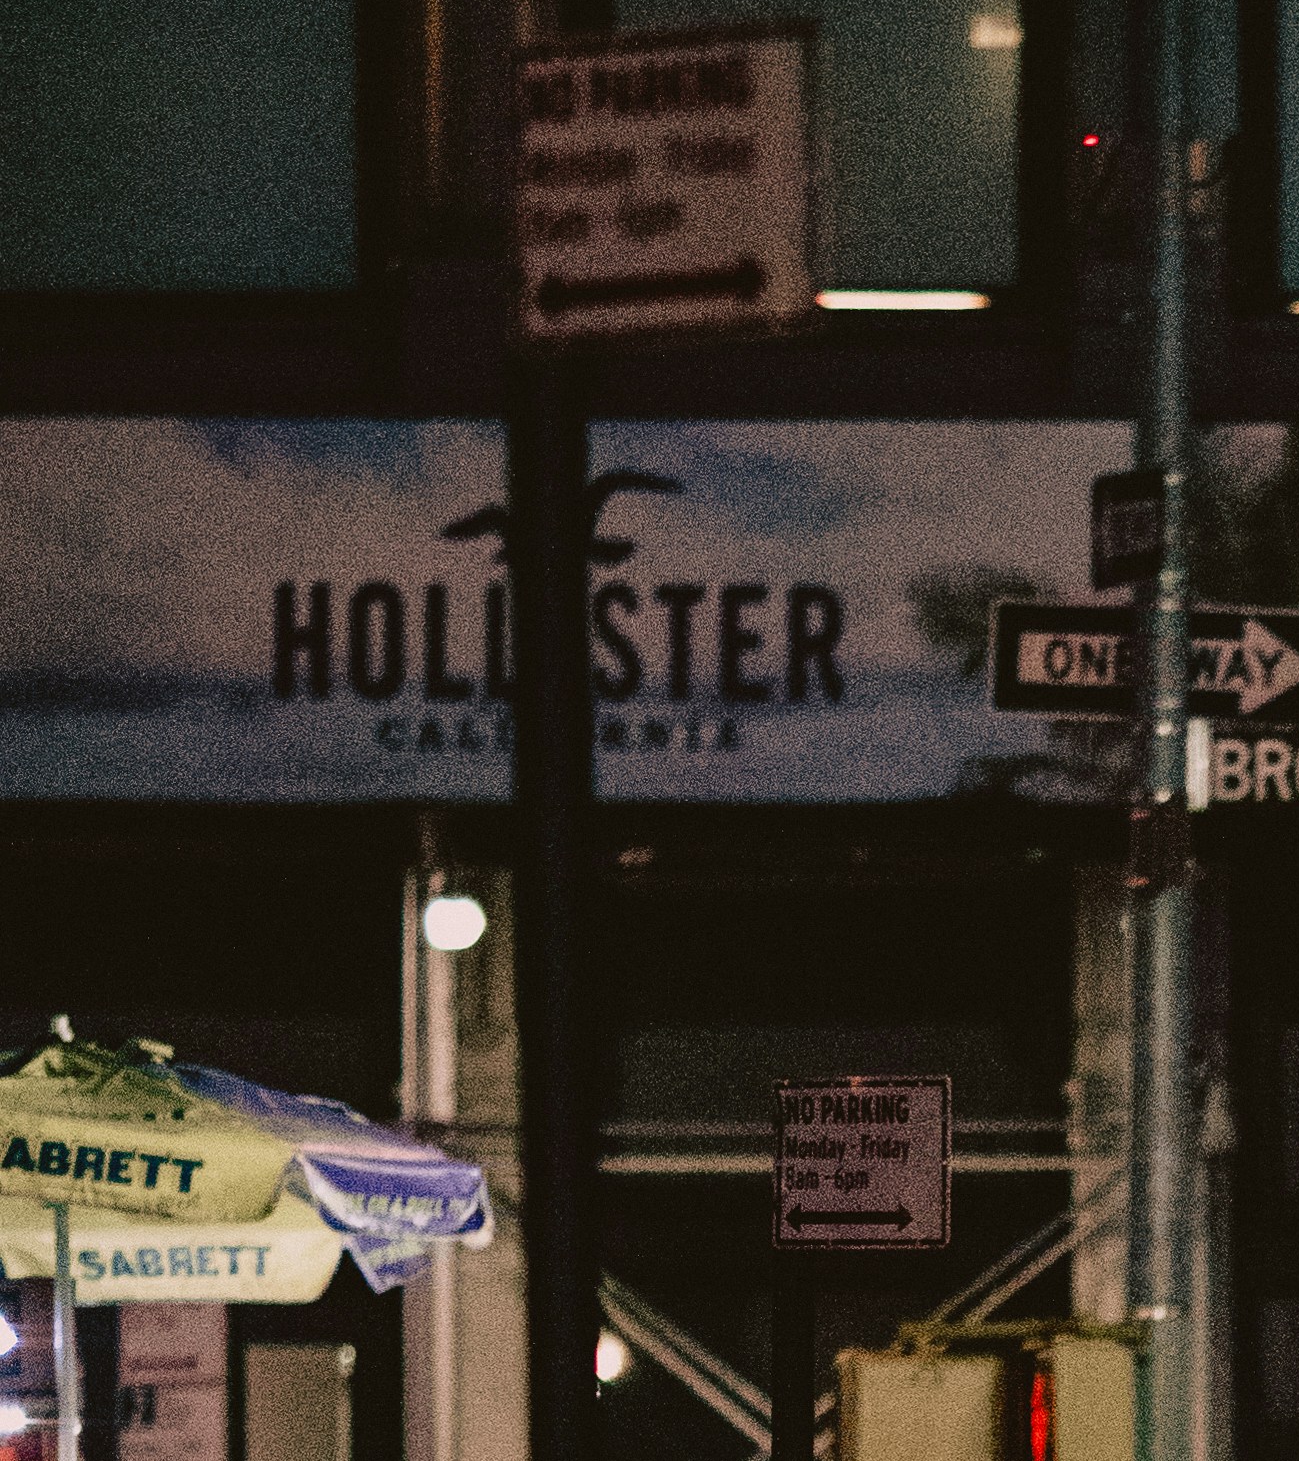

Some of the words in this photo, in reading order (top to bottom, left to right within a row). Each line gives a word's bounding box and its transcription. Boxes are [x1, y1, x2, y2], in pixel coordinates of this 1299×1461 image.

[271, 579, 844, 701] HOLLSTER
[784, 1095, 814, 1124] NO
[821, 1095, 910, 1124] PARKING
[1, 1137, 203, 1193] ABRETT
[78, 1246, 271, 1281] SABRETT
